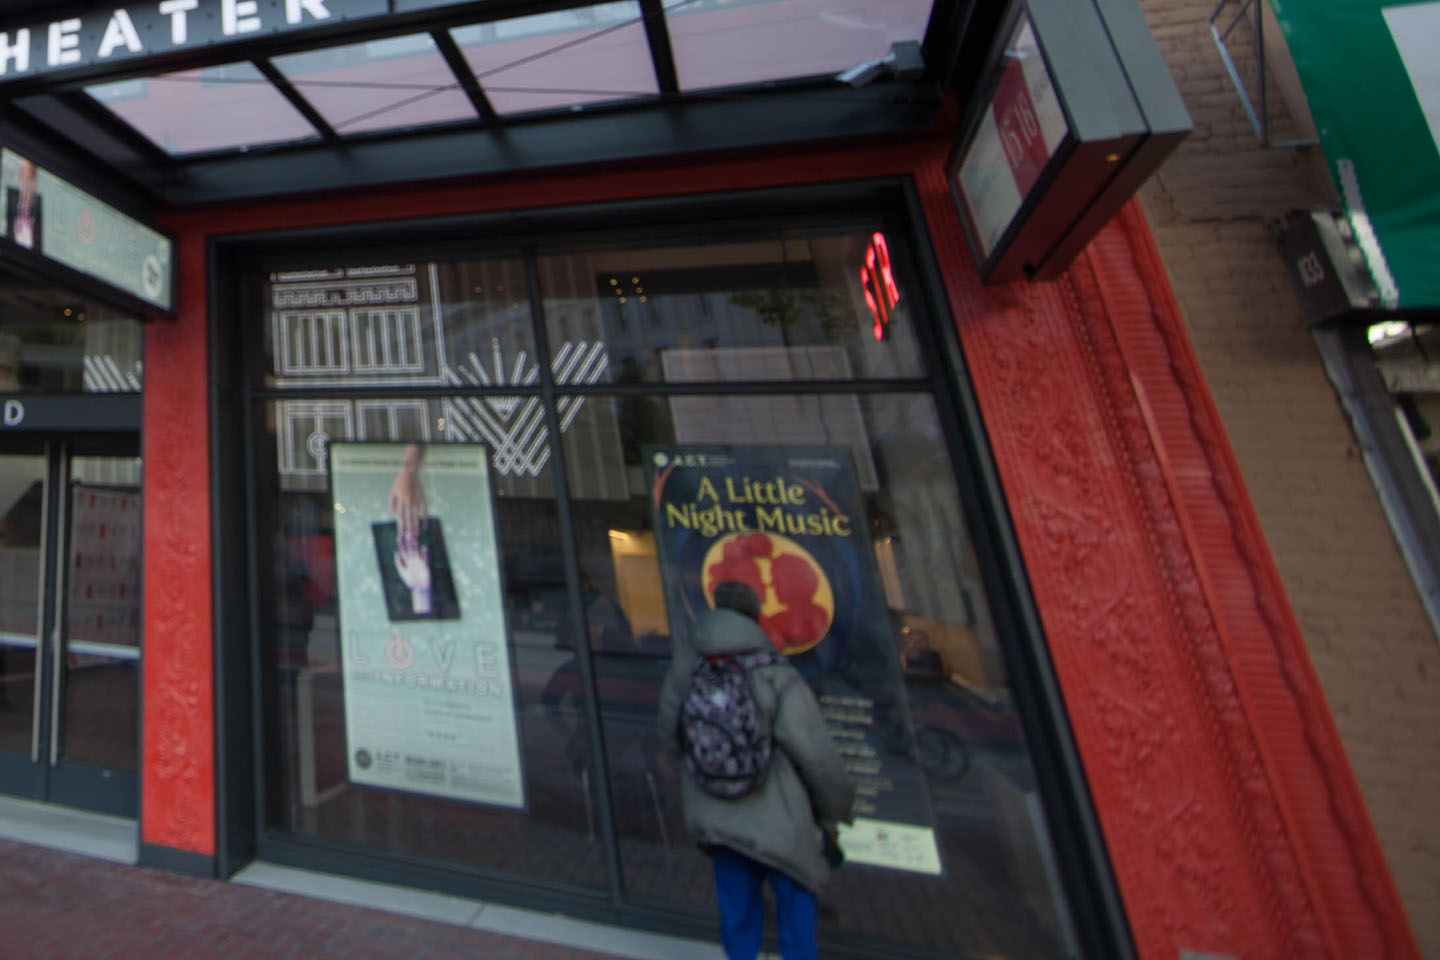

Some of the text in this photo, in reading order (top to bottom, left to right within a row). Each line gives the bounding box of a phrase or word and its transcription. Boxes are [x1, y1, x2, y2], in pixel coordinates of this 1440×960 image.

[696, 476, 807, 505] A Little
[665, 502, 851, 538] Night Music
